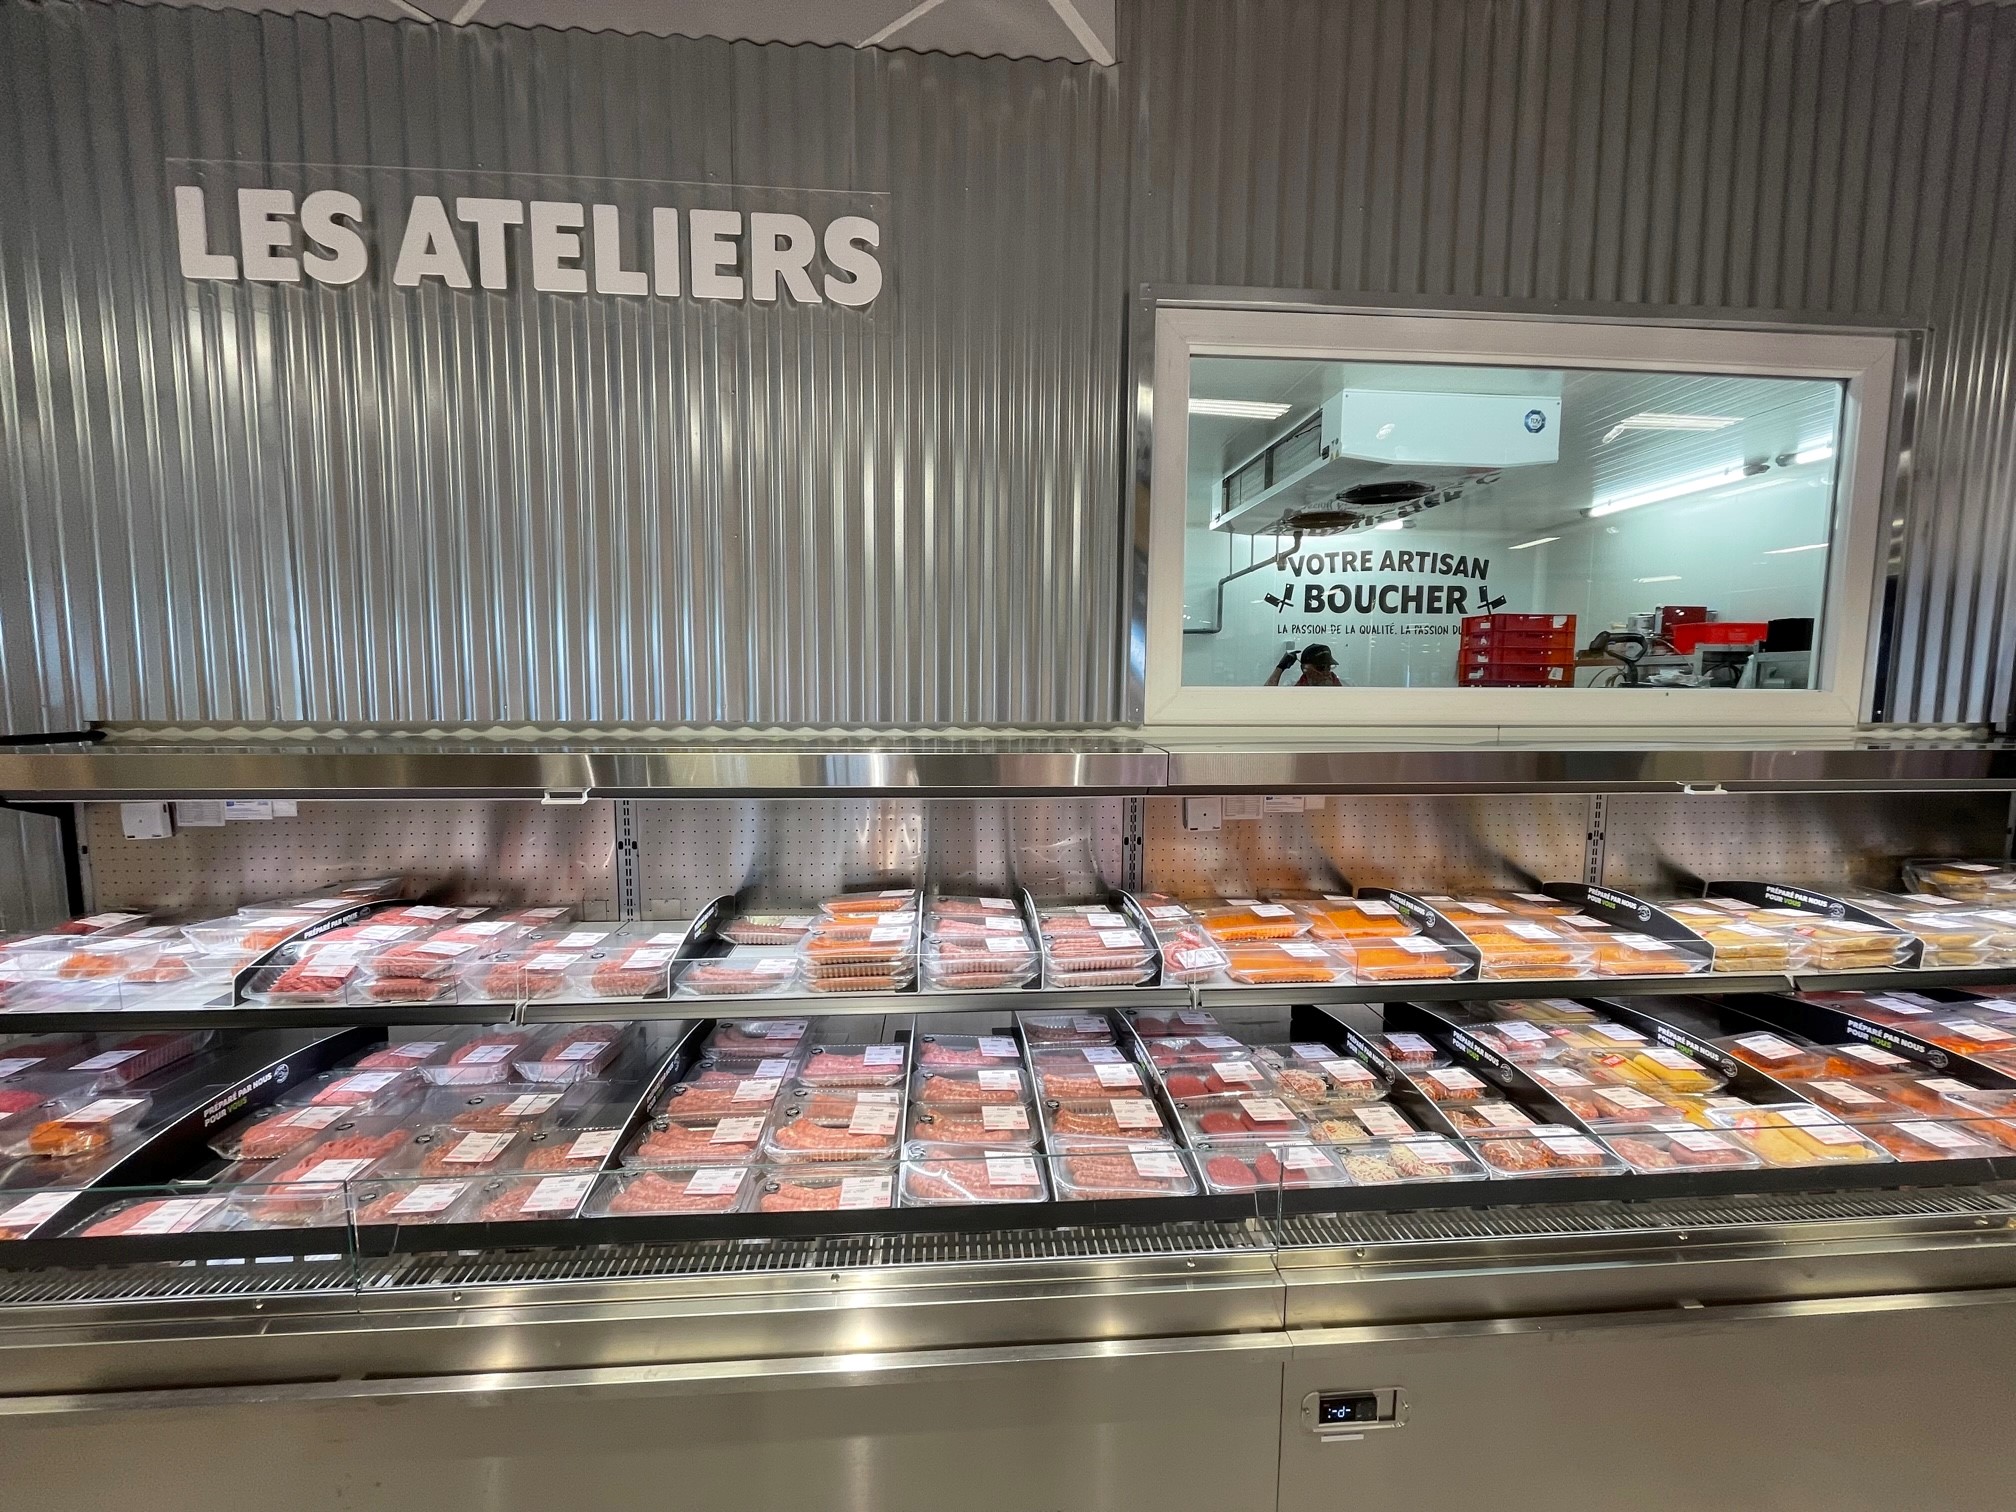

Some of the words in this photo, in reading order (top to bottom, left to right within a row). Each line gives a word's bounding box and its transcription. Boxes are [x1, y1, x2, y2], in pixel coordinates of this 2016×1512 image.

[174, 185, 369, 285] LES
[393, 195, 884, 307] ATELIERS
[1288, 551, 1373, 577] VOTRE
[1379, 550, 1489, 580] ARTISAN
[1304, 584, 1468, 614] BOUCHER
[1278, 624, 1288, 634] LA
[1291, 624, 1327, 635] PASSION
[1331, 624, 1341, 635] DE
[1345, 624, 1355, 634] LA
[1401, 625, 1411, 635] LA
[1414, 625, 1448, 635] PASSION
[1587, 894, 1601, 904] POUR
[1588, 887, 1610, 900] PRÉPARÉ
[1610, 895, 1621, 904] PAR
[1621, 899, 1637, 909] NOUS
[1765, 893, 1783, 902] POUR
[1784, 898, 1801, 907] VOUS
[1767, 886, 1794, 898] PRÉPARÉ
[1795, 893, 1808, 902] PAR
[1808, 897, 1828, 907] NOUS
[1452, 1038, 1466, 1052] POUR
[1453, 1030, 1474, 1049] PRÉPARÉ
[1474, 1044, 1485, 1056] PAR
[1484, 1051, 1499, 1066] NOUS
[1657, 1033, 1675, 1047] POUR
[1657, 1026, 1686, 1045] PRÉPARÉ
[1686, 1039, 1700, 1052] PAR
[1700, 1046, 1720, 1061] NOUS
[1847, 1019, 1883, 1037] PRÉPARÉ
[1883, 1032, 1900, 1043] PAR
[1901, 1038, 1925, 1053] NOUS
[1847, 1027, 1869, 1040] POUR
[1870, 1036, 1892, 1048] VOUS
[203, 1091, 237, 1118] PRÉPARÉ
[237, 1084, 252, 1098] PAR
[252, 1072, 273, 1089] NOUS
[204, 1109, 227, 1127] POUR
[227, 1096, 248, 1112] VOUS
